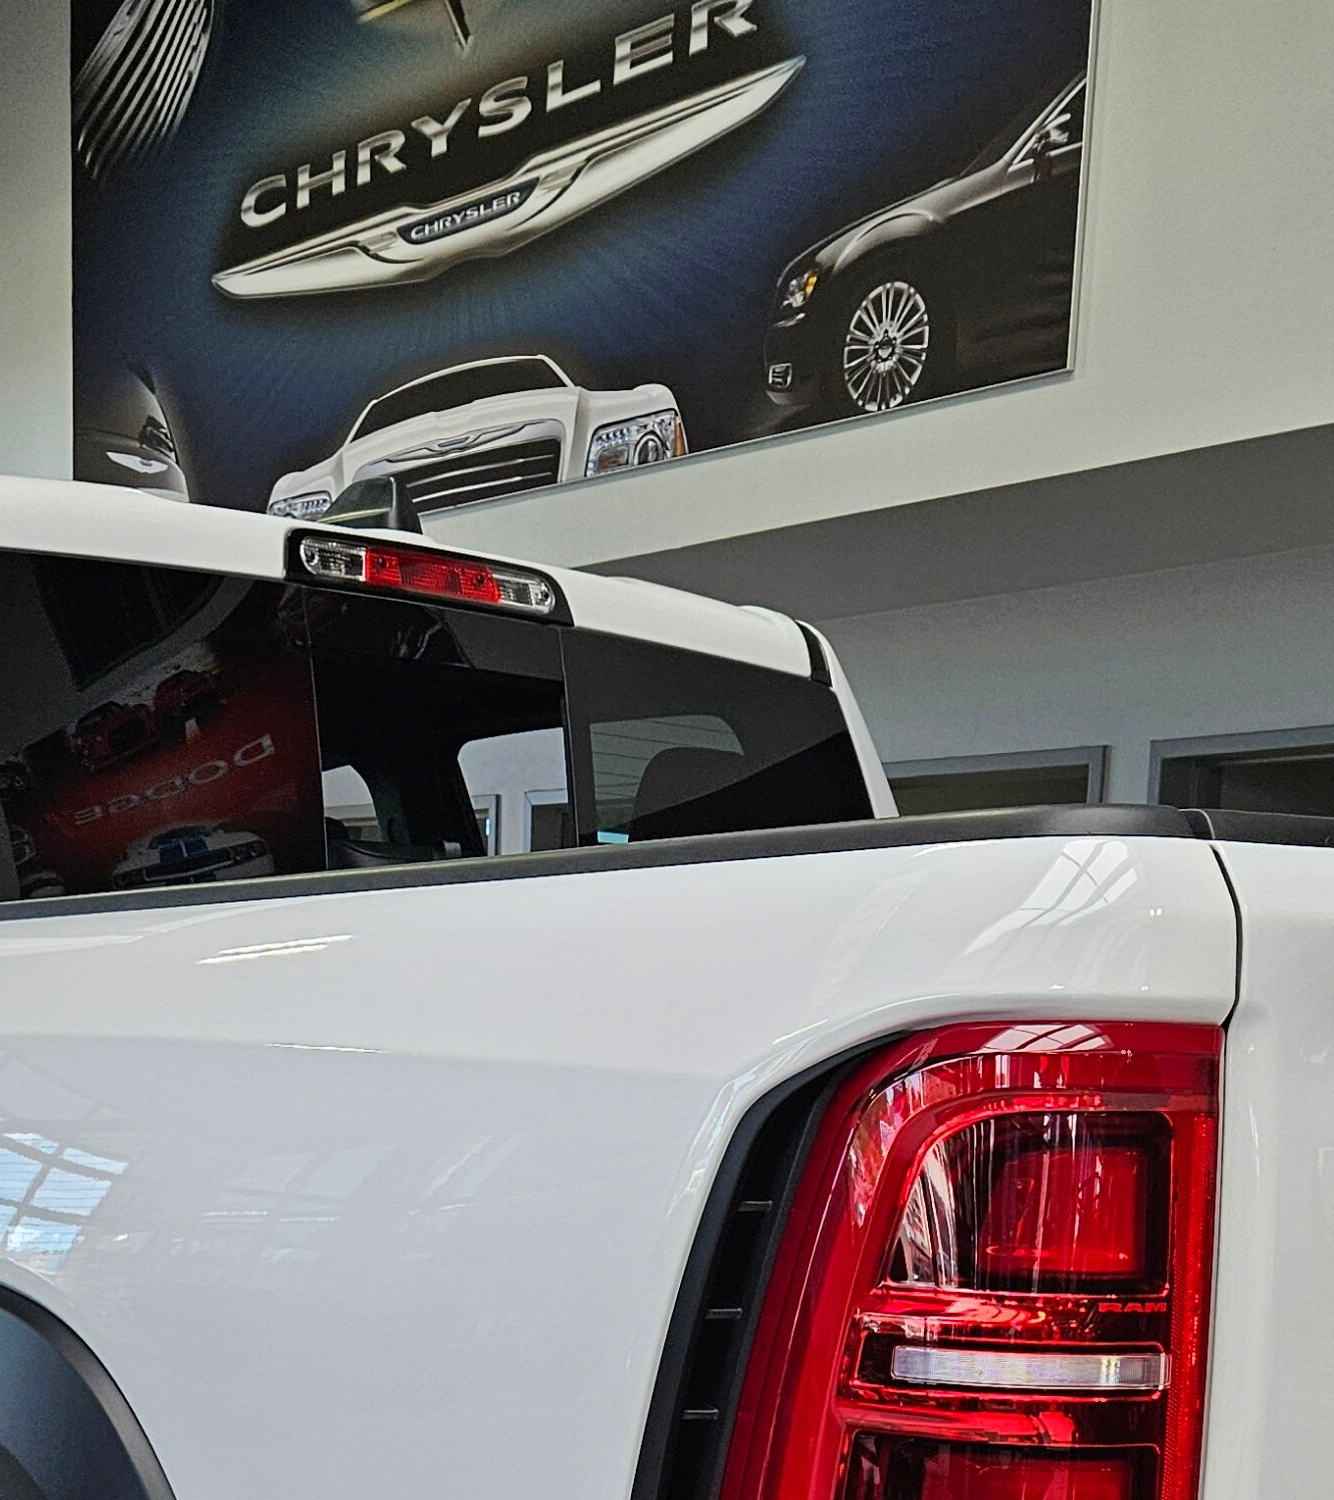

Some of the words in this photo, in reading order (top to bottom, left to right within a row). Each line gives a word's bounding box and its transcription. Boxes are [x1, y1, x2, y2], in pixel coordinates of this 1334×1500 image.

[240, 0, 759, 229] CHRYSLER
[410, 190, 522, 241] CHRYSLER
[1098, 1302, 1167, 1313] RAM
